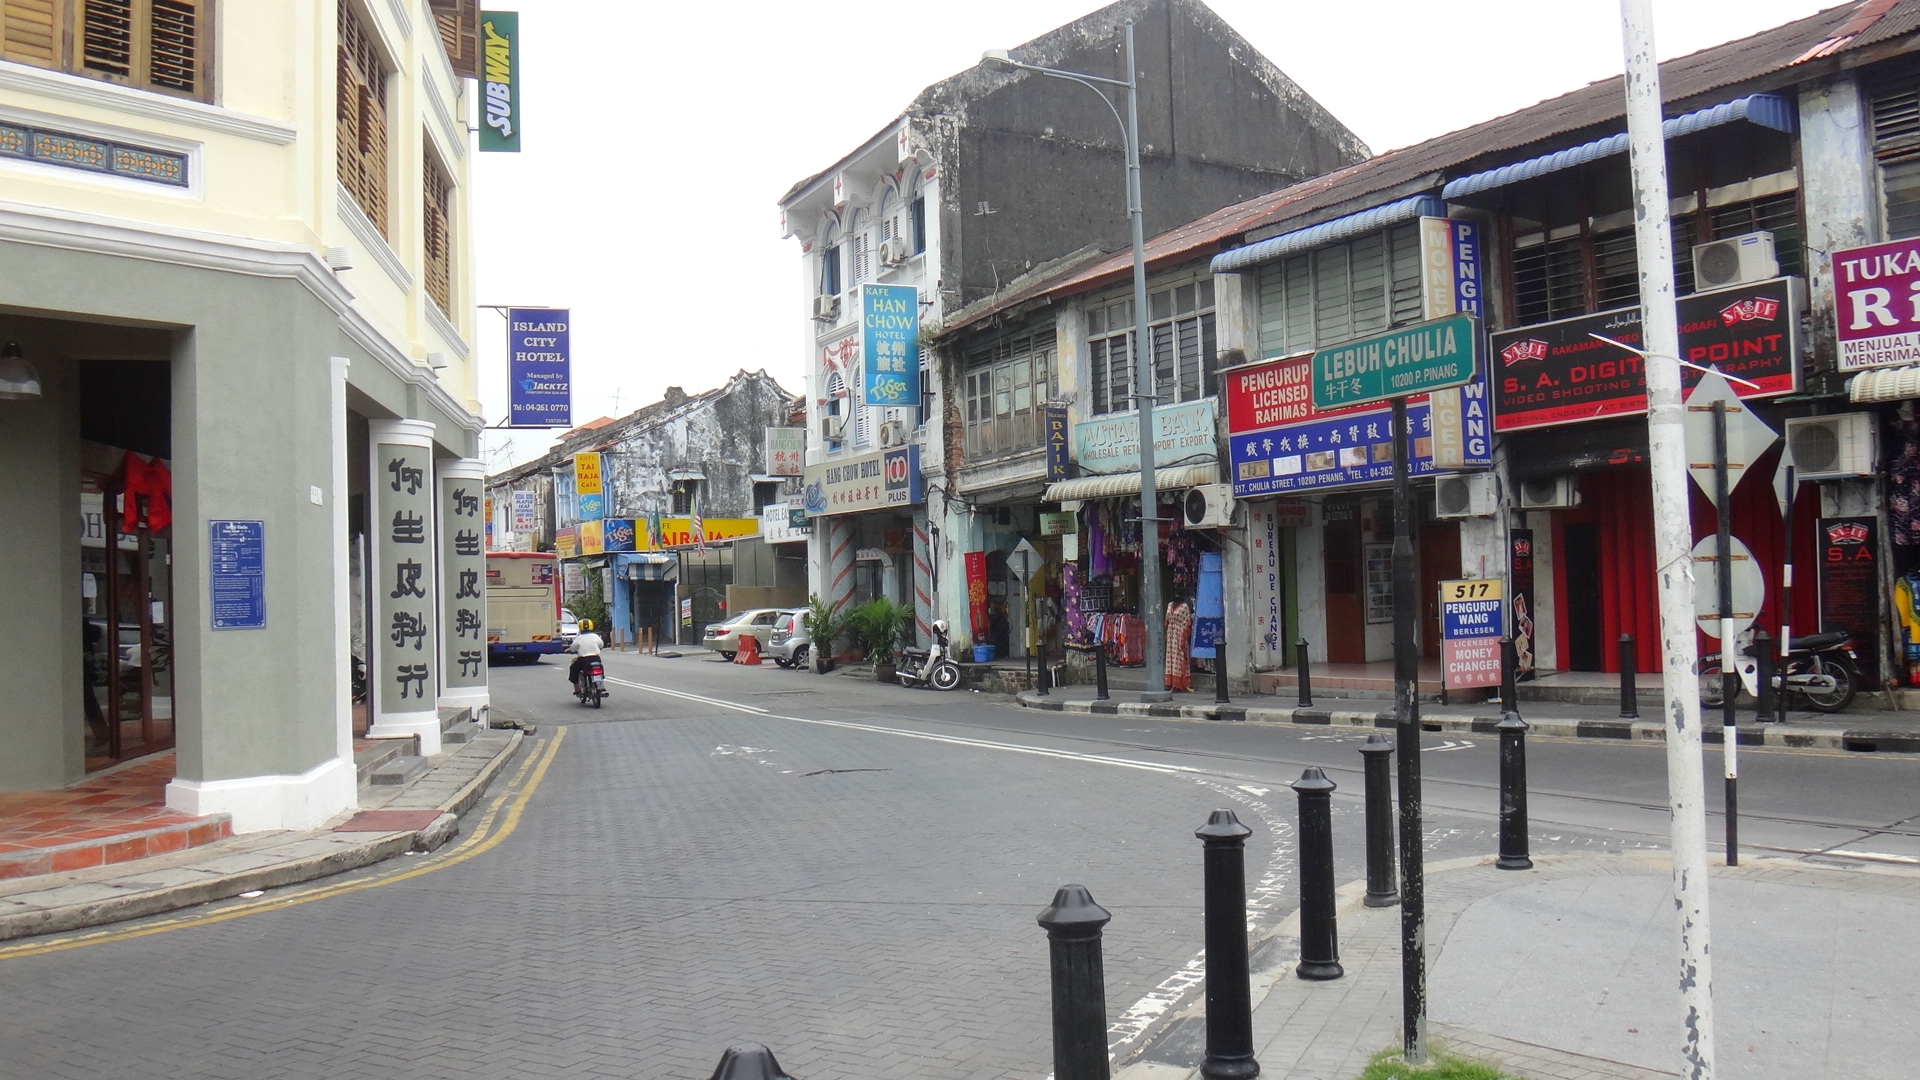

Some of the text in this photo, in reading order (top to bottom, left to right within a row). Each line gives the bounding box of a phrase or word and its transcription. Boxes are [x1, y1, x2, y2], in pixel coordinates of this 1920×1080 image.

[483, 21, 512, 137] SUBWAY
[866, 287, 889, 296] KAFE
[873, 298, 906, 313] HAN
[513, 322, 567, 332] ISLAND
[866, 314, 914, 330] CHOW
[524, 337, 557, 347] CITY
[875, 331, 906, 340] HOTEL
[1844, 335, 1911, 354] MENJUAL
[516, 352, 565, 362] HOTEL
[1324, 325, 1457, 382] LEBUH CHULIA
[1688, 333, 1783, 364] POINT
[1241, 363, 1309, 394] PENGURUP
[1390, 363, 1458, 389] 10200 P. PINANG
[1570, 357, 1646, 383] DIGIT
[870, 378, 907, 401] Tiger
[1253, 384, 1308, 409] LICENSED
[1325, 377, 1362, 400] 牛干冬
[1503, 392, 1545, 406] VIDEO
[1552, 379, 1631, 399] SHOOTING
[550, 404, 568, 412] 0770
[1255, 402, 1307, 425] RAHIMAS
[1464, 382, 1486, 457] WANG
[1050, 421, 1065, 474] BATIK
[1083, 447, 1119, 462] WHOLESALE
[1153, 439, 1175, 452] MPORT
[1180, 434, 1208, 448] EXPORT
[826, 459, 880, 485] HANG CHOW HOTEL
[886, 455, 907, 484] 100
[1249, 481, 1270, 492] CHULIA
[1271, 478, 1296, 489] STREET,
[1298, 475, 1316, 486] 10200
[1318, 472, 1346, 483] PENANG.
[1351, 470, 1363, 479] TEL
[888, 490, 907, 502] PLUS
[766, 508, 780, 523] HOTEL
[605, 526, 634, 543] Tiger
[1267, 514, 1275, 567] BUREAU
[1269, 573, 1276, 591] DE
[1455, 583, 1489, 598] 517
[1446, 600, 1499, 614] PENGURUP
[1458, 613, 1489, 625] WANG
[1453, 626, 1494, 636] BERLESEN
[1453, 639, 1494, 648] LICENSED
[1455, 648, 1493, 660] MONEY
[1449, 659, 1500, 673] CHANGER
